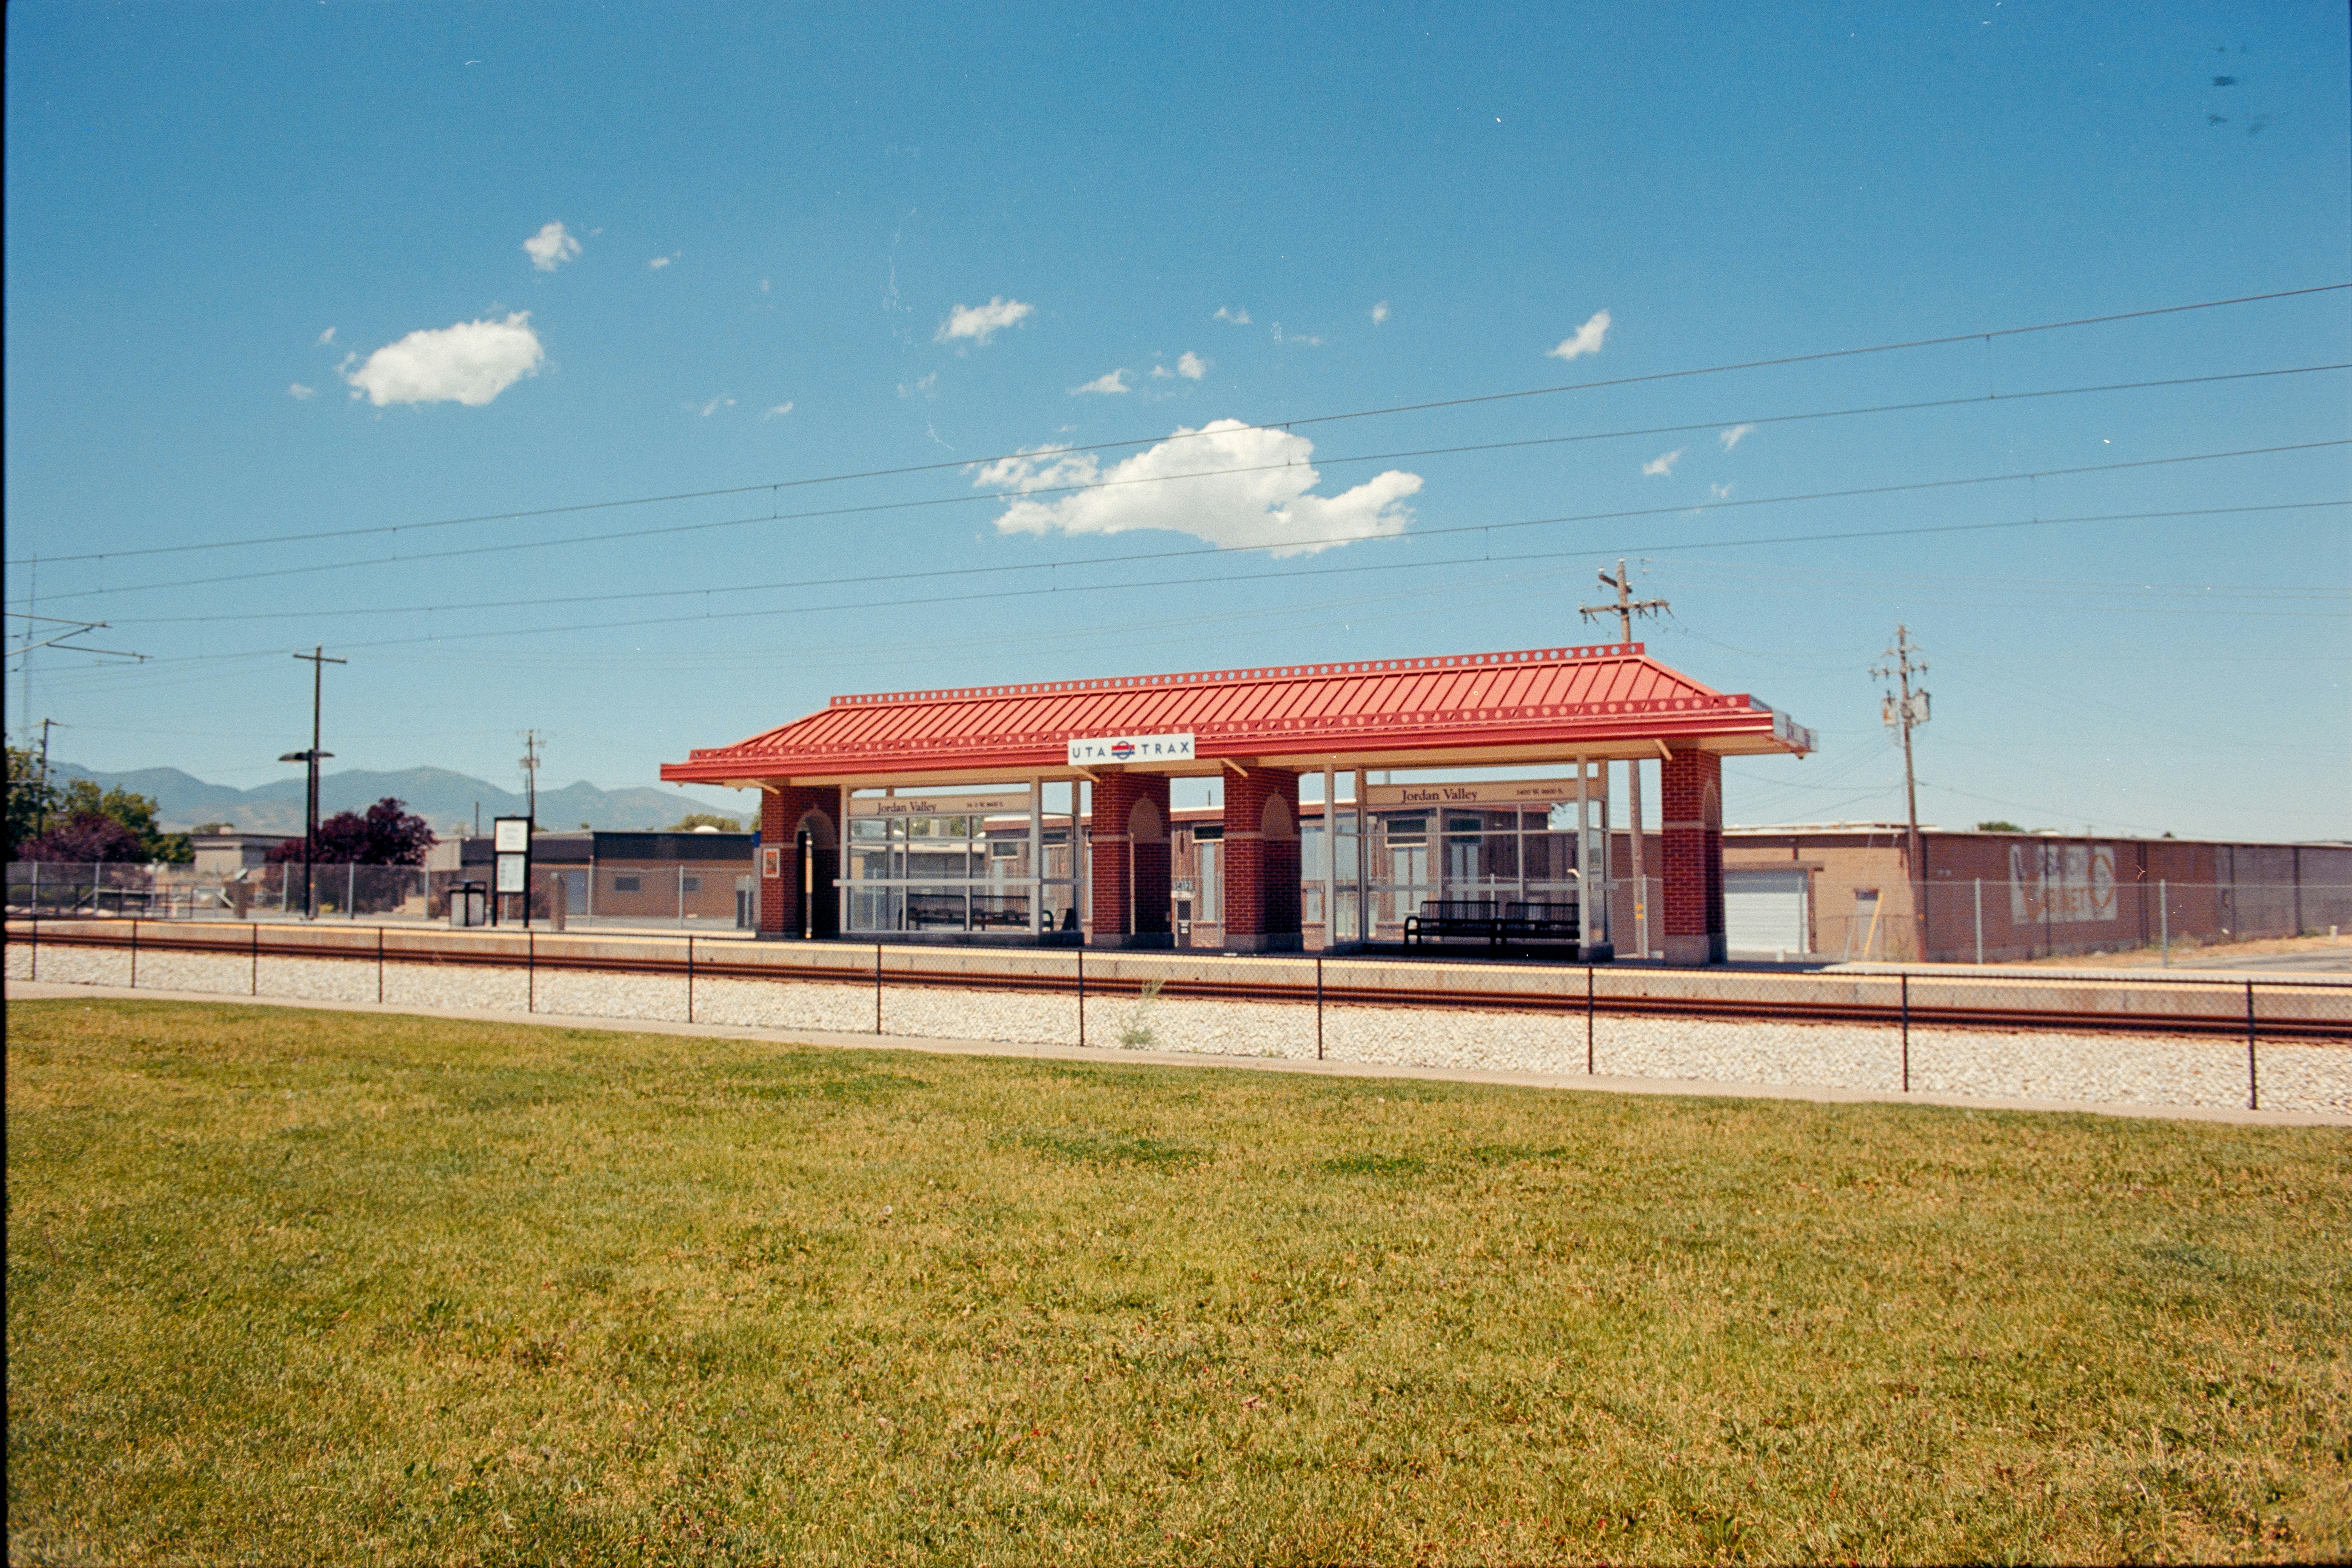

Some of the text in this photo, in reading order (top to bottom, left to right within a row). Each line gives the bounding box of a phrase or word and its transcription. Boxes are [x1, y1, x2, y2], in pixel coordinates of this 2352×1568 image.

[1072, 742, 1189, 758] UTA TRAX
[1401, 788, 1478, 804] Jordan Valley
[876, 801, 937, 815] Jordan Valley
